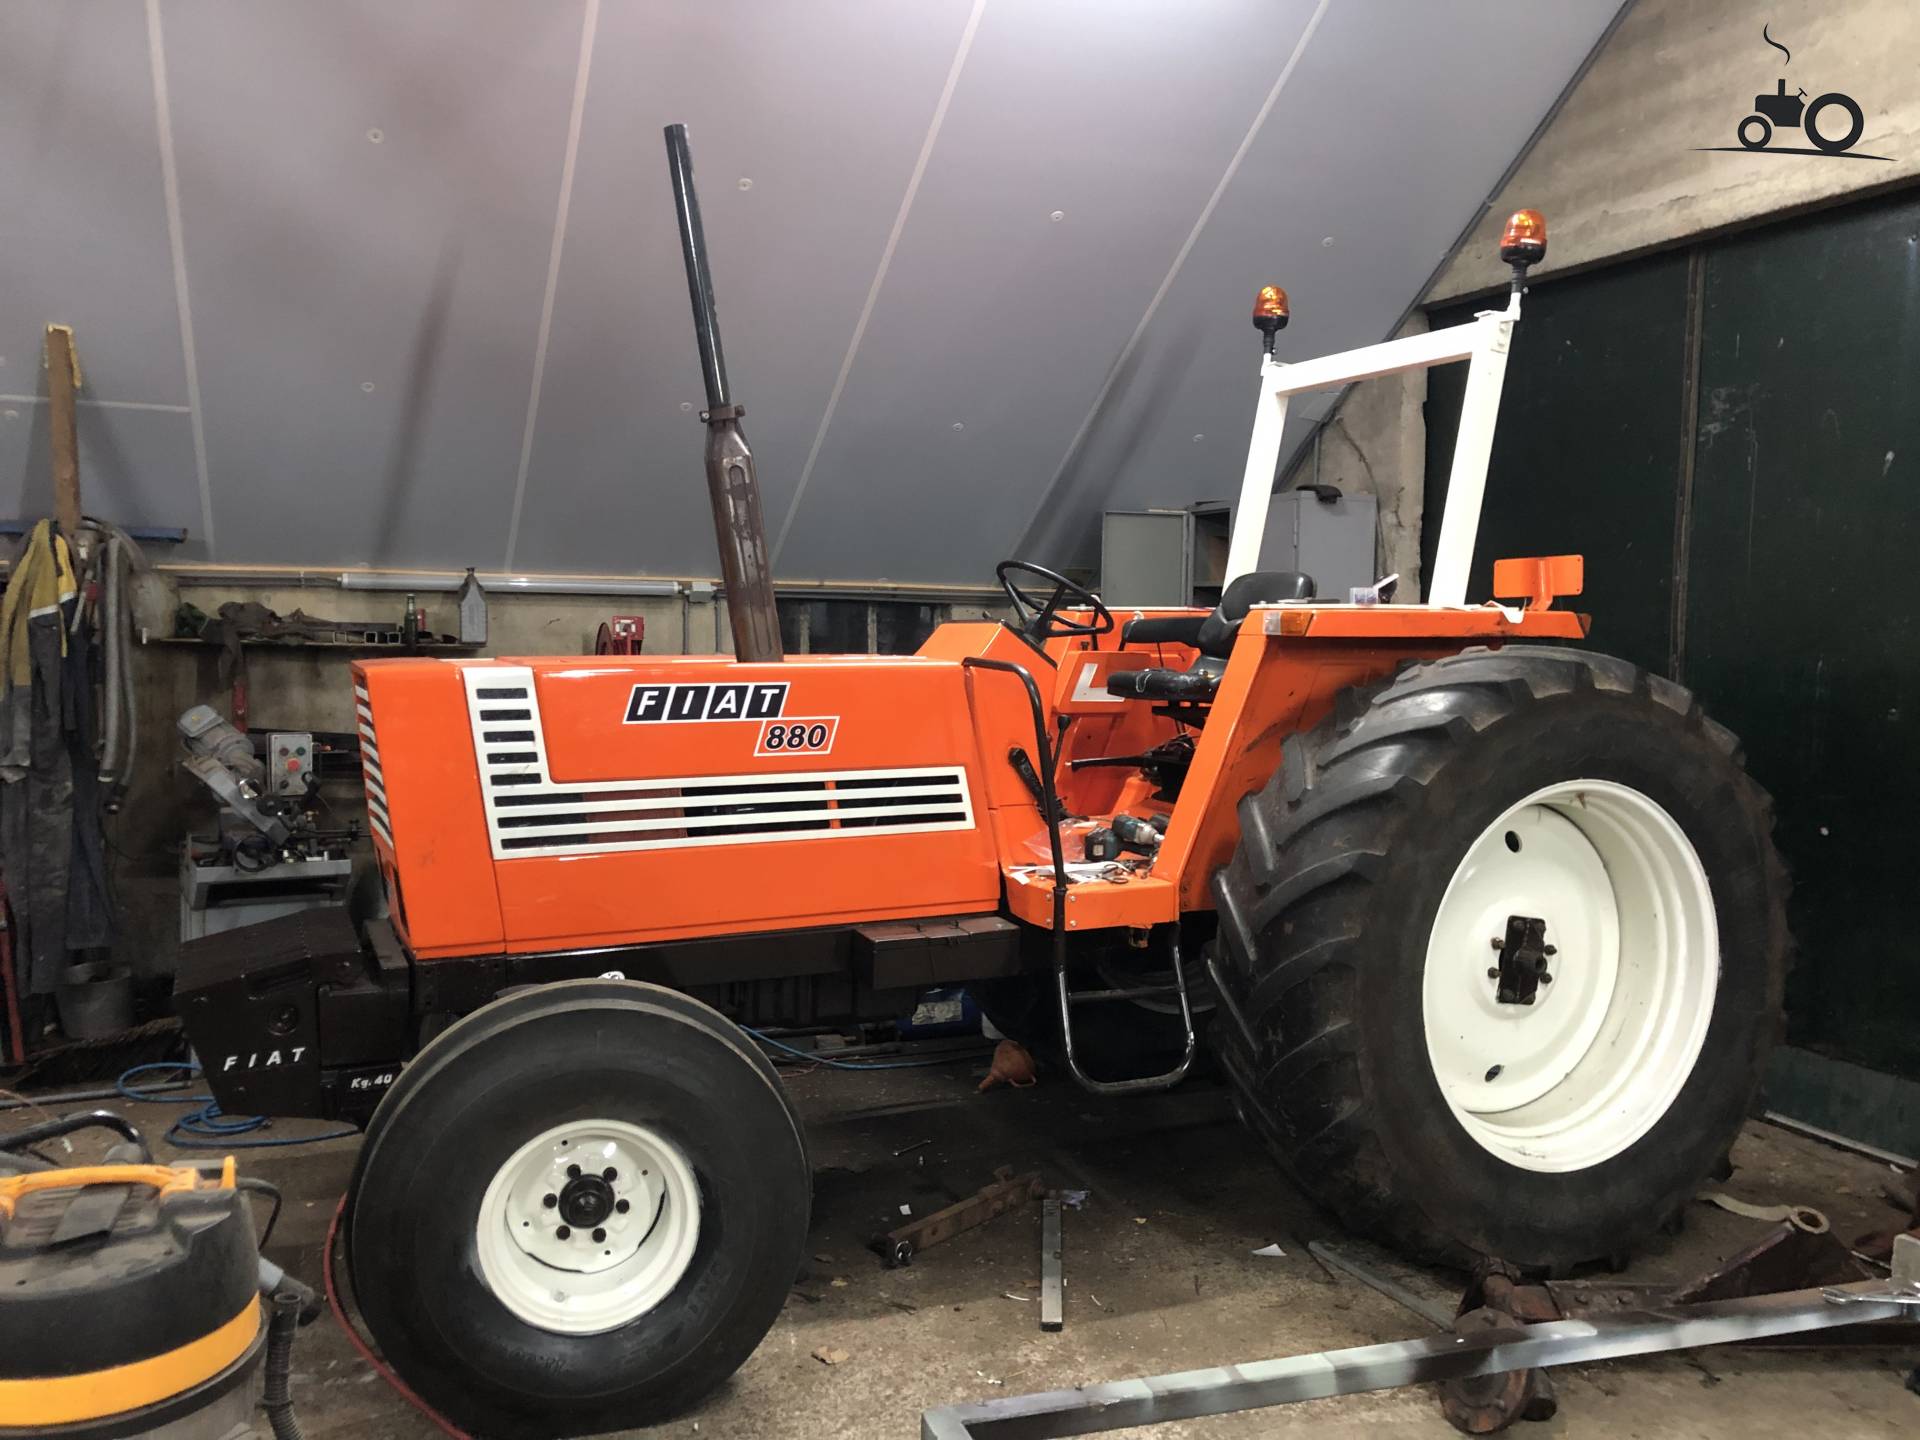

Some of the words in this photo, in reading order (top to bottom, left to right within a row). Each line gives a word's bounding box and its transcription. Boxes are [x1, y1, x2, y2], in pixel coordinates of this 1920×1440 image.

[636, 688, 780, 716] FIAT
[765, 724, 828, 751] 880
[223, 1047, 306, 1072] FIAT
[350, 1077, 372, 1089] Kg.
[374, 1073, 393, 1085] 40
